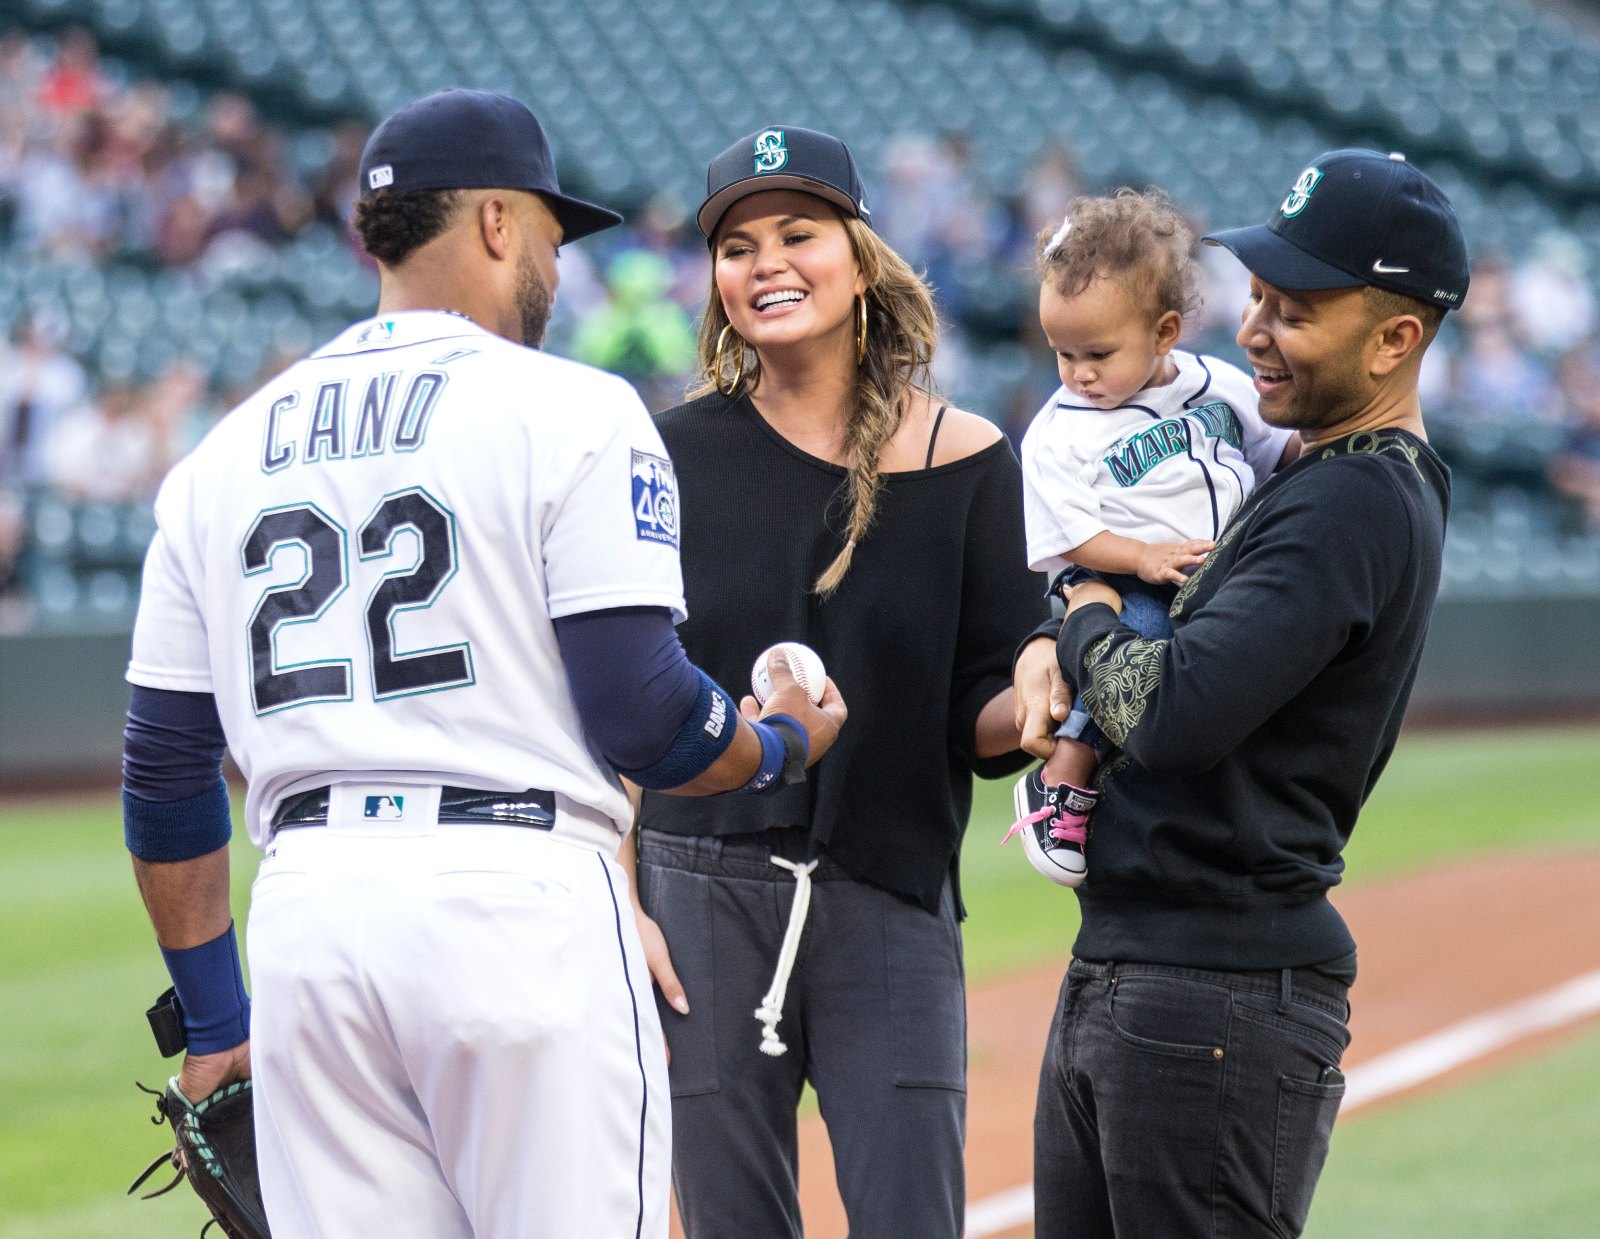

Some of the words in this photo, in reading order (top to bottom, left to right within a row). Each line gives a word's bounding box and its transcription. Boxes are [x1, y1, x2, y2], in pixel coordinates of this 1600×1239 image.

[753, 130, 789, 175] S
[1433, 290, 1459, 302] DRI-FIT
[636, 486, 676, 536] 40
[240, 485, 477, 718] 22
